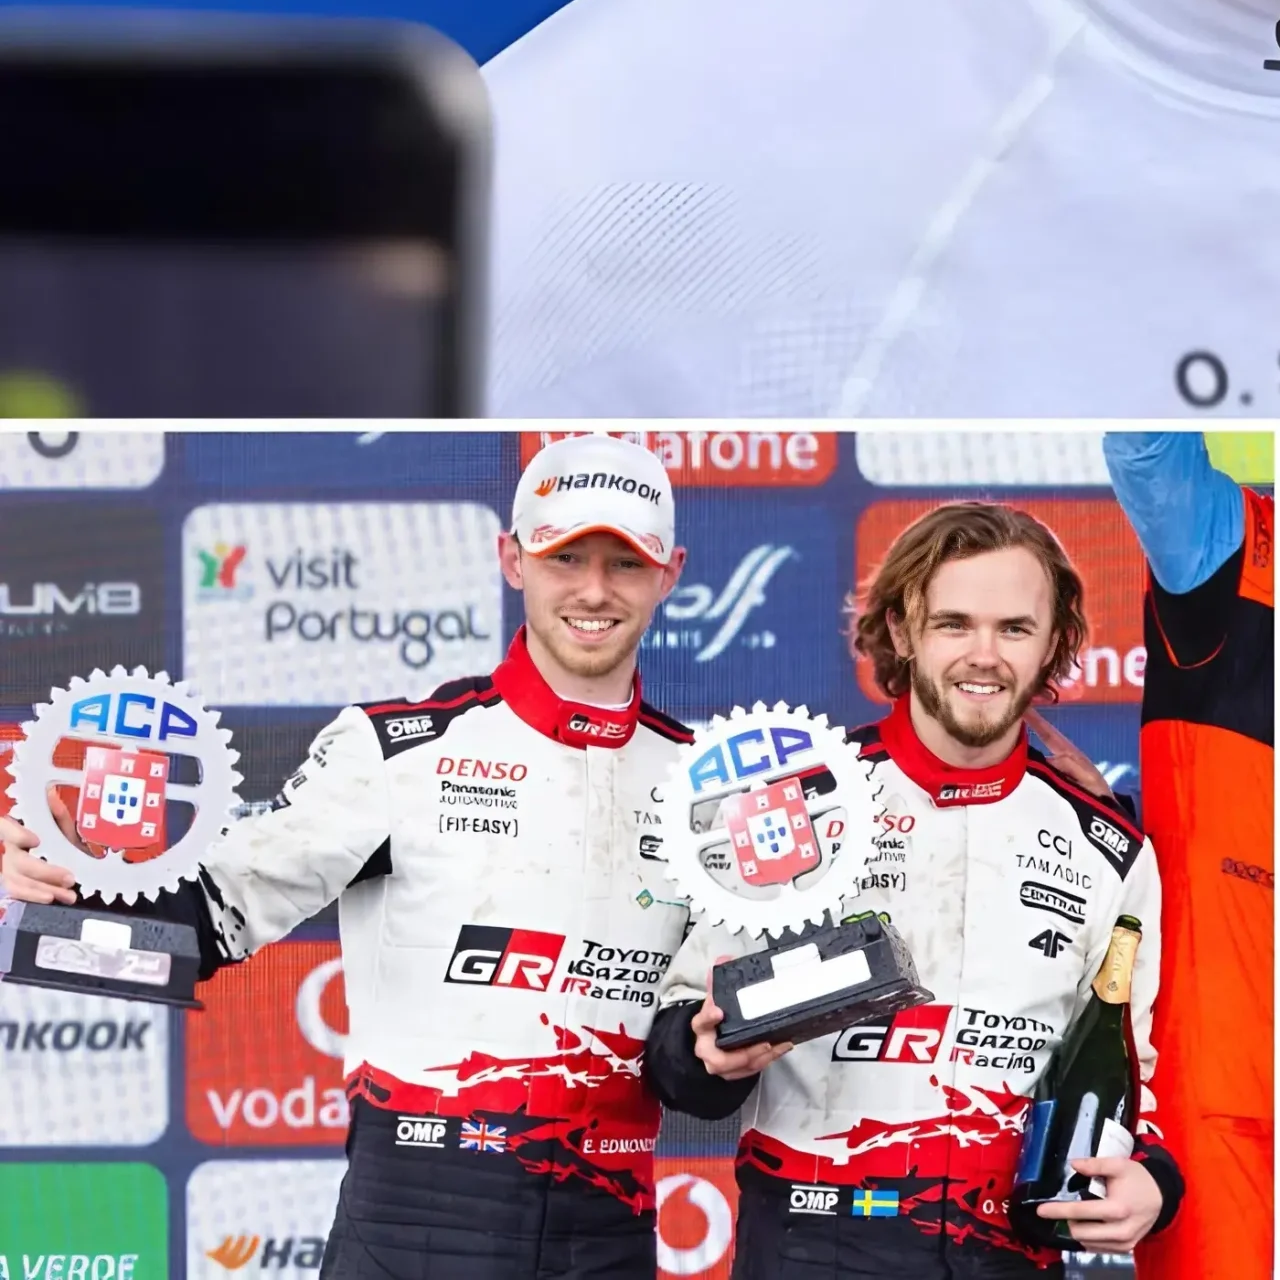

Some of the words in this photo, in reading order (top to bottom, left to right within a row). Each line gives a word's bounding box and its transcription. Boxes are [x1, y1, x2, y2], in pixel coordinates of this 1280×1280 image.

[1175, 350, 1253, 408] O.
[265, 548, 360, 589] visit
[665, 544, 801, 663] olf
[263, 602, 491, 670] Portugal
[70, 692, 198, 742] ACP
[386, 718, 433, 737] OMP
[435, 756, 528, 782] DENSO
[687, 726, 814, 794] ACP
[1037, 828, 1073, 861] CCI
[1090, 820, 1130, 854] OMP
[1015, 854, 1093, 890] TAMADIC
[1020, 886, 1086, 917] CENTRAL
[581, 939, 673, 969] TOYOTA
[1028, 928, 1074, 959] 4F
[448, 948, 556, 991] GR
[834, 1024, 942, 1063] GR
[954, 1027, 1048, 1052] GAZOO
[949, 1045, 1037, 1075] Racing
[206, 1076, 349, 1128] voda
[396, 1121, 447, 1143] OMP
[789, 1189, 840, 1211] OMP
